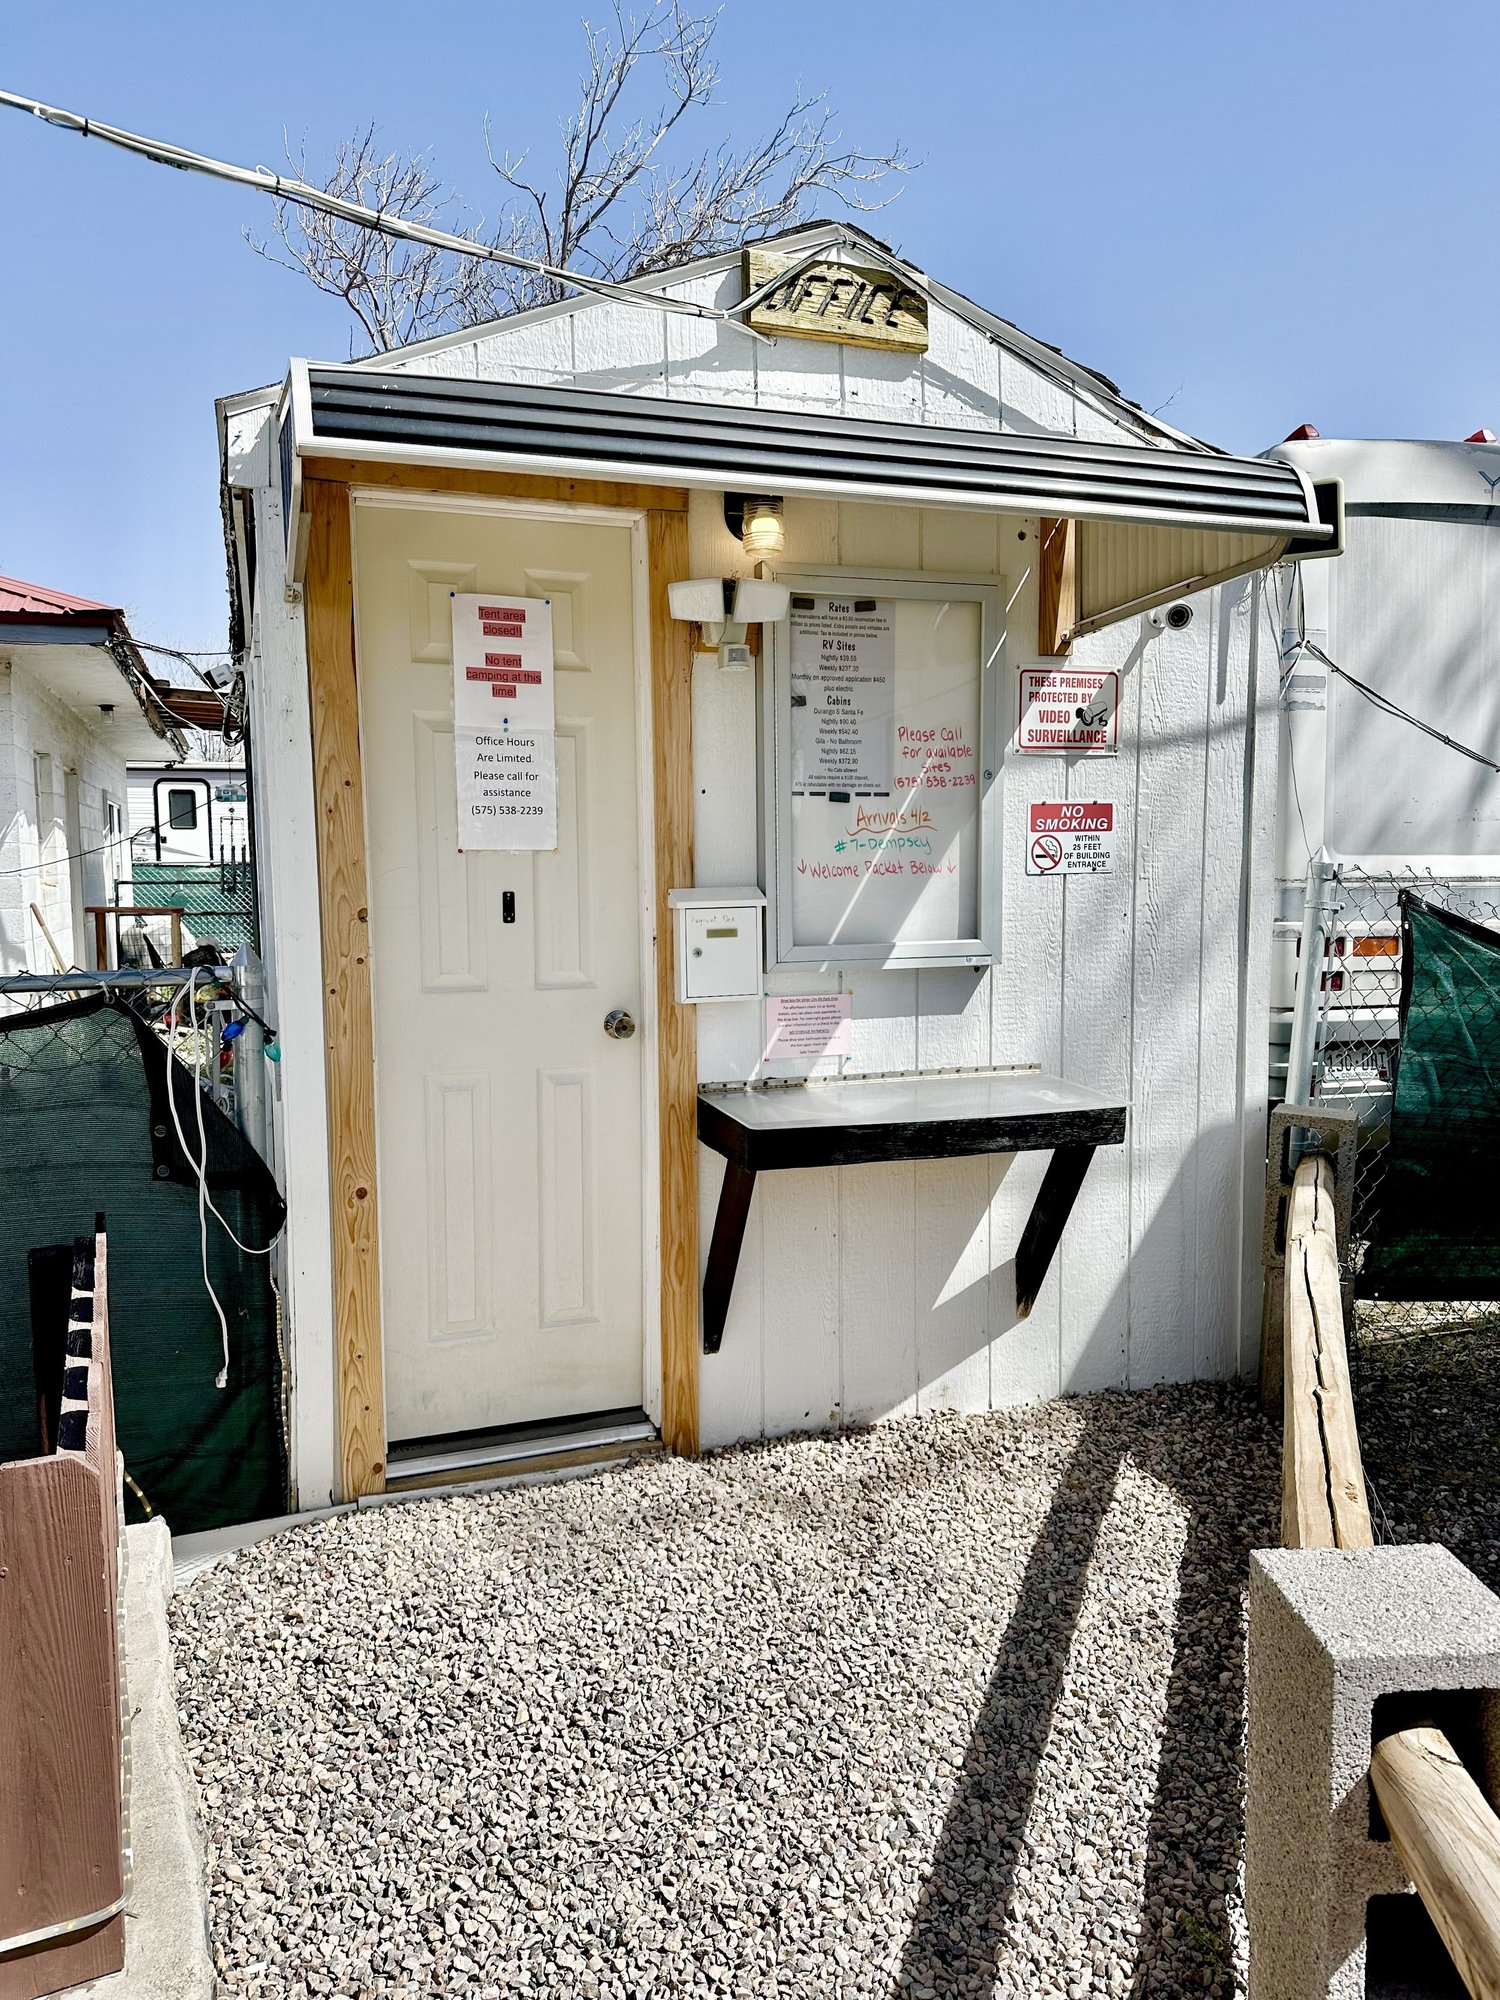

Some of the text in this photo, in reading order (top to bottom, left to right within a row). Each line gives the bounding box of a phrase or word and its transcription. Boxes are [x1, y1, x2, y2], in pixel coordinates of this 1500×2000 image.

[829, 602, 849, 613] Rates
[479, 608, 525, 620] Tent area
[483, 625, 522, 635] closed!!
[823, 640, 855, 651] RV Sites
[486, 655, 521, 666] No tent
[821, 654, 838, 662] Nightly
[819, 664, 837, 672] Weekly
[466, 670, 541, 682] camping at this
[792, 673, 811, 681] Monthly
[1029, 676, 1103, 689] THESE PREMISES
[492, 686, 516, 696] time!
[827, 695, 851, 706] Cabins
[1029, 692, 1093, 703] PROTECTED BY
[814, 708, 835, 716] Durango
[1039, 710, 1070, 724] VIDEO
[821, 718, 838, 726] Nightly
[898, 726, 962, 742] Please Call
[1028, 729, 1107, 744] SURVEILLANCE
[476, 736, 535, 747] Office Hours
[902, 745, 972, 758] for available
[477, 753, 534, 763] Are Limited.
[474, 771, 539, 781] Please call for
[894, 776, 923, 790] (575)
[483, 789, 531, 797] assistance
[471, 805, 543, 816] (575) 538-2239
[1061, 806, 1084, 818] NO
[1036, 818, 1108, 830] SMOKING
[1075, 834, 1100, 842] WITHIN
[1073, 843, 1101, 851] 25 FEET
[1064, 851, 1111, 860] OF BUILDING
[810, 860, 942, 879] Welcome Packet Below
[1068, 860, 1107, 868] ENTRANCE
